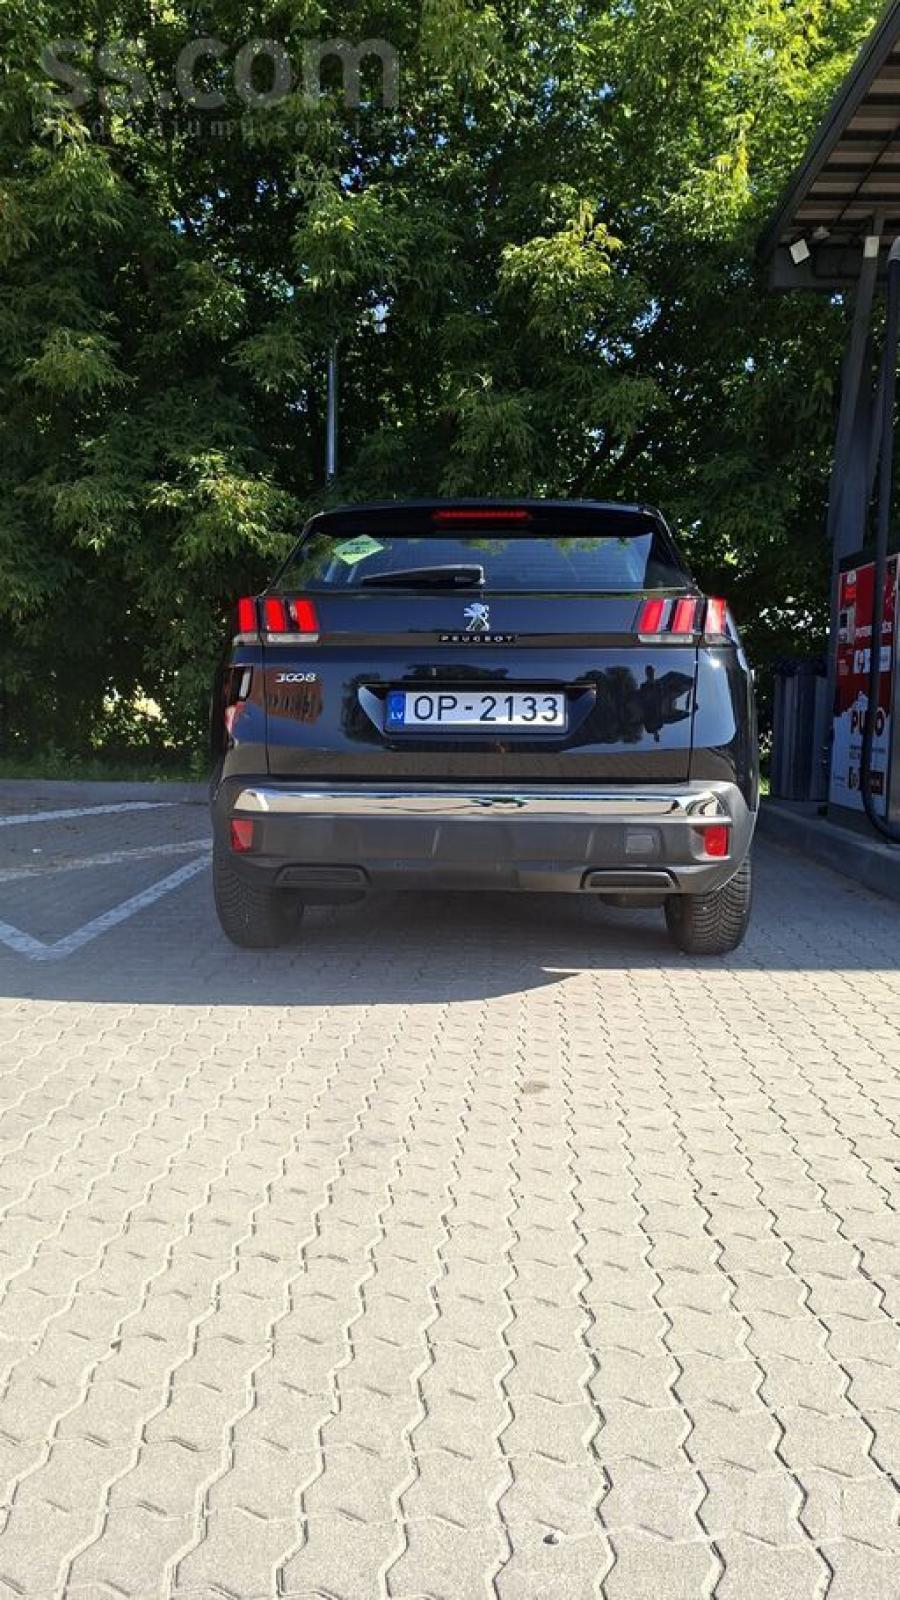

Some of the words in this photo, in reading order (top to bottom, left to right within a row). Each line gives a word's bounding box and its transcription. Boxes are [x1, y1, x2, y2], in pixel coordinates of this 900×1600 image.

[440, 634, 514, 644] PEUGEOT
[274, 672, 317, 683] 3008
[414, 695, 559, 722] OP-2133
[391, 710, 404, 720] LV
